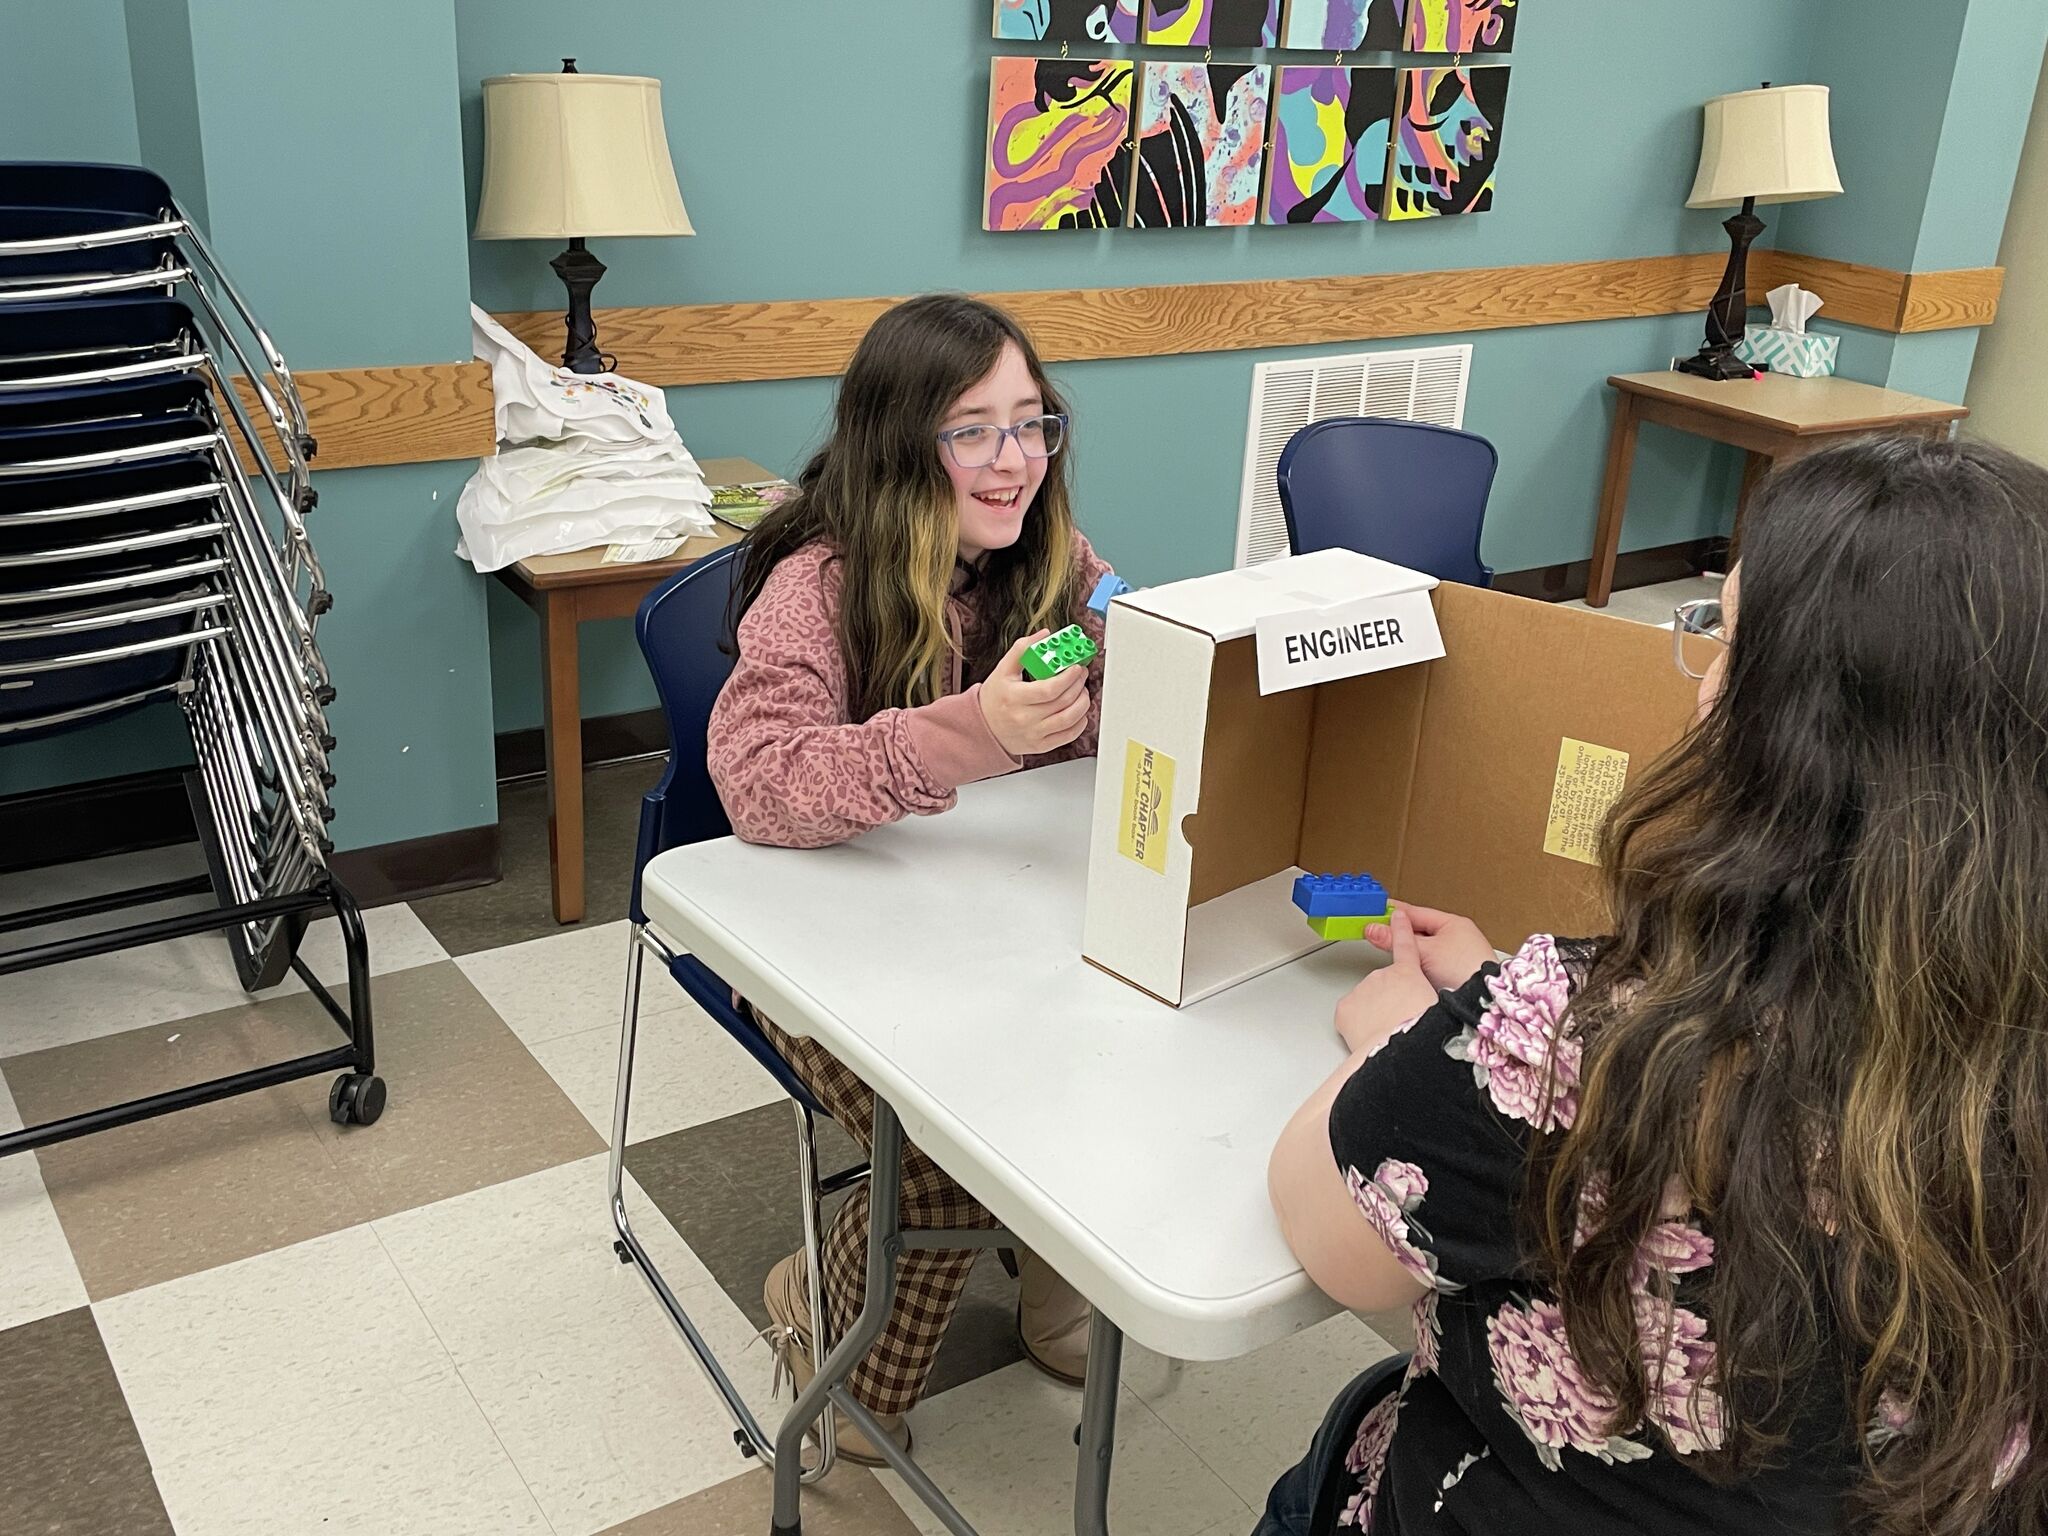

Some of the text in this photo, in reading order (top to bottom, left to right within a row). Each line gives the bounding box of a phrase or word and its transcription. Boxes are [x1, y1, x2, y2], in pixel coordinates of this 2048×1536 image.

[1285, 618, 1404, 664] ENGINEER
[1594, 759, 1604, 785] three
[1602, 754, 1612, 777] card
[1611, 759, 1618, 772] on
[1559, 774, 1572, 818] library at
[1560, 745, 1584, 852] online or by calling the
[1605, 774, 1615, 796] your
[1135, 747, 1154, 861] NEXT CHAPTER
[1573, 789, 1583, 821] renew
[1575, 758, 1596, 847] wish to keep them
[1568, 823, 1577, 847] them
[1581, 832, 1590, 850] you
